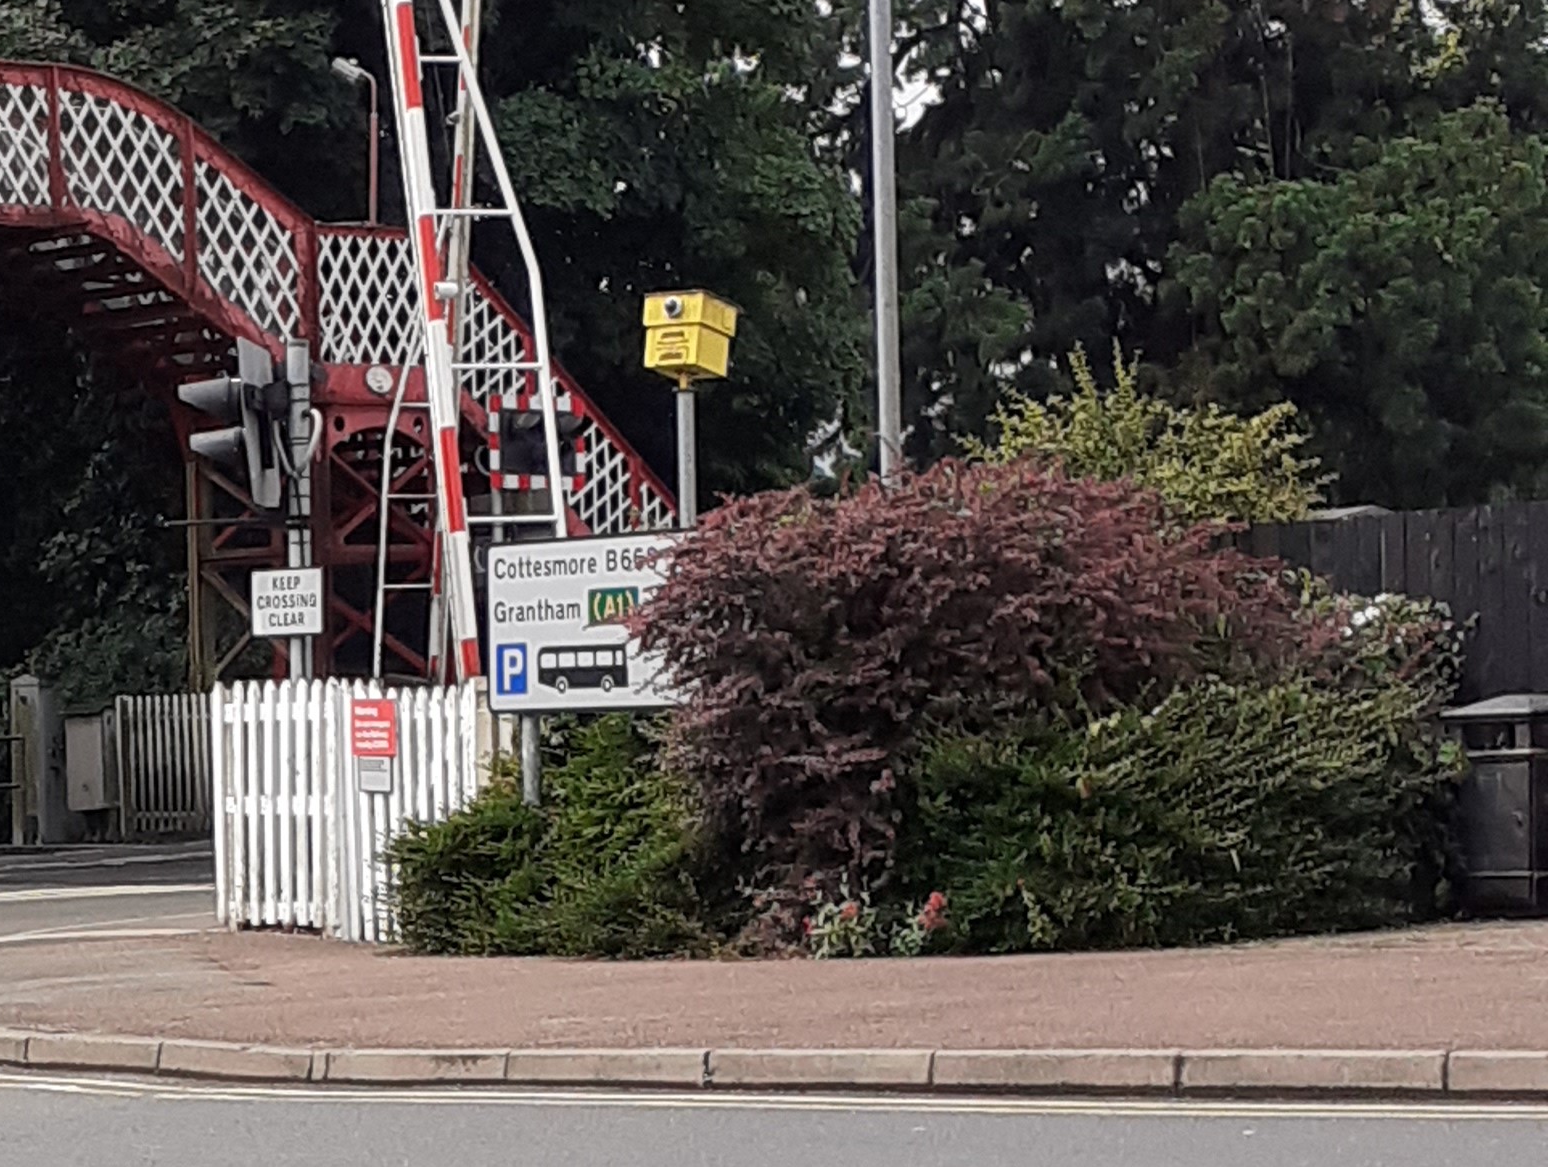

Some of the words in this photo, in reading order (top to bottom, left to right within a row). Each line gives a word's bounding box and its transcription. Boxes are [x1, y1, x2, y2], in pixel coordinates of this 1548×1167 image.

[494, 555, 597, 579] Cottesmore
[272, 576, 301, 590] KEEP
[257, 592, 317, 609] CROSSING
[269, 611, 305, 627] CLEAR
[494, 599, 581, 623] Grantham
[503, 648, 524, 691] P
